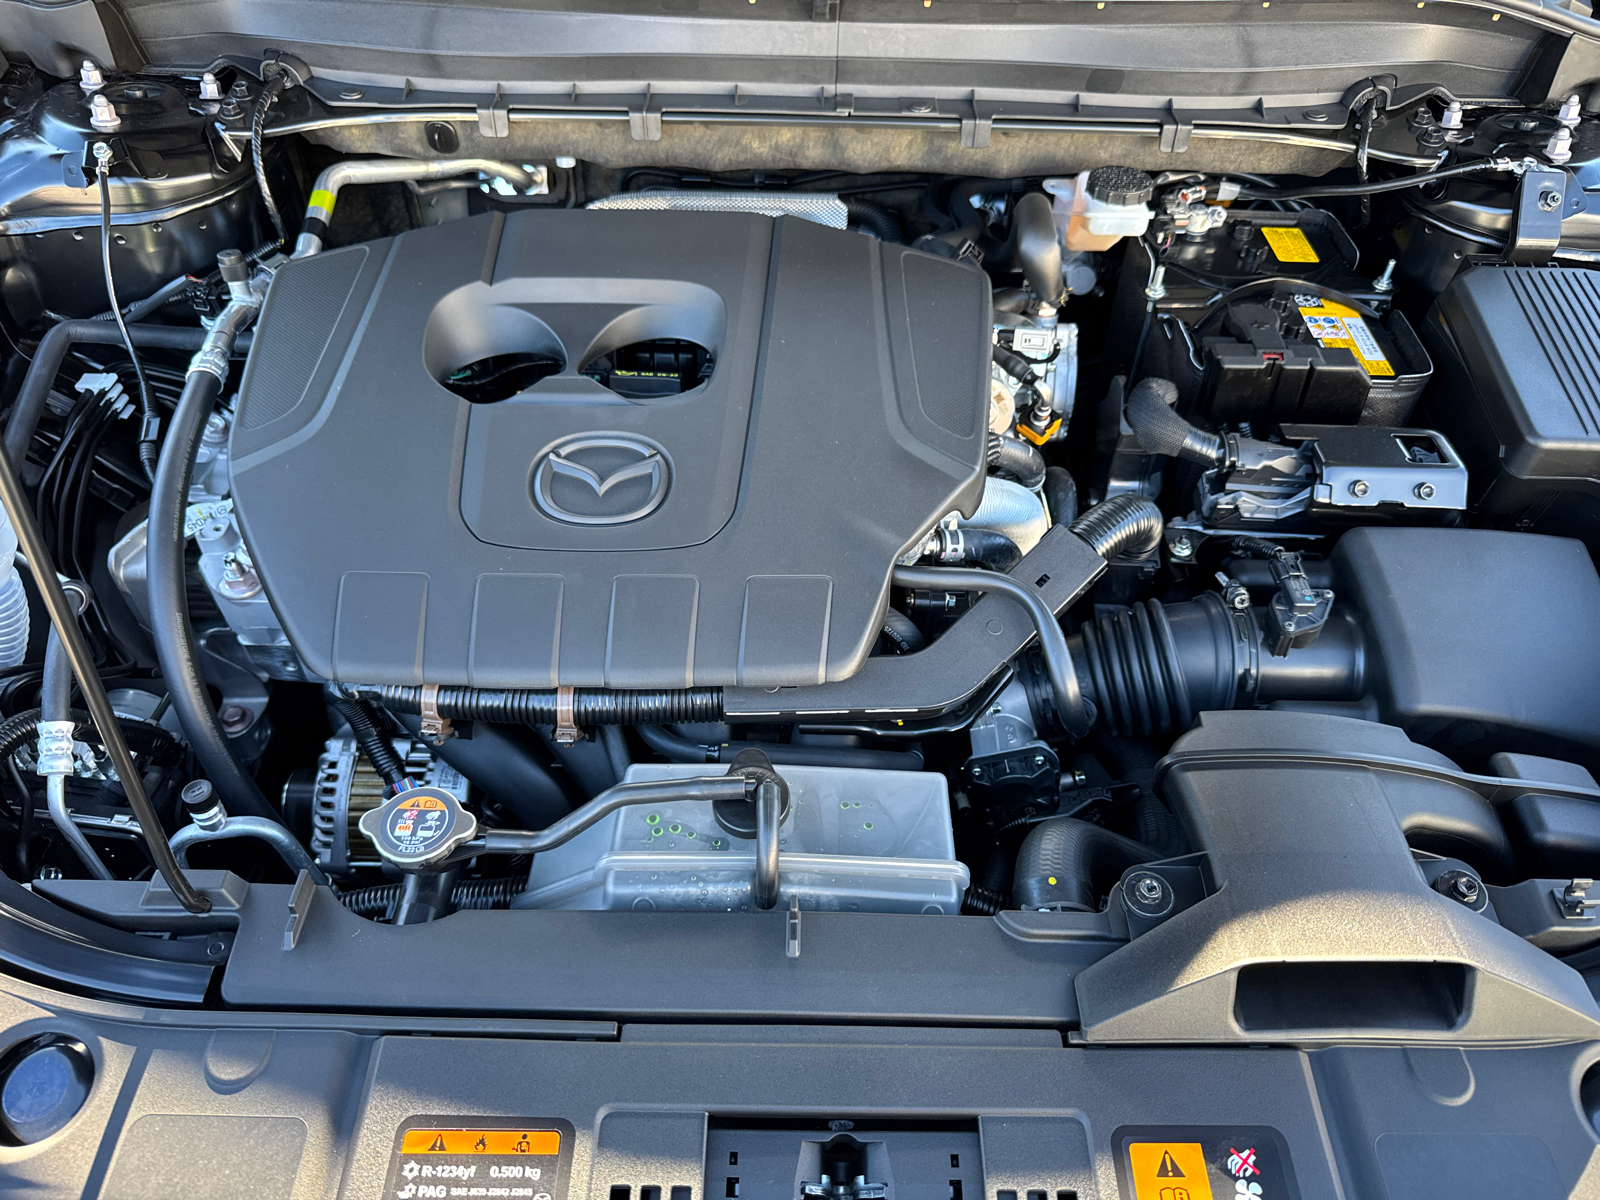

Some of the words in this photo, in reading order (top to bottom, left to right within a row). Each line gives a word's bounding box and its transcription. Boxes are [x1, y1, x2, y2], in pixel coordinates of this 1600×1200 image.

[398, 845, 415, 853] FL22
[421, 1165, 477, 1180] R-1234yf
[489, 1165, 523, 1178] 0.500
[524, 1165, 541, 1181] kg
[417, 1185, 447, 1198] PAG
[450, 1187, 468, 1196] SAE
